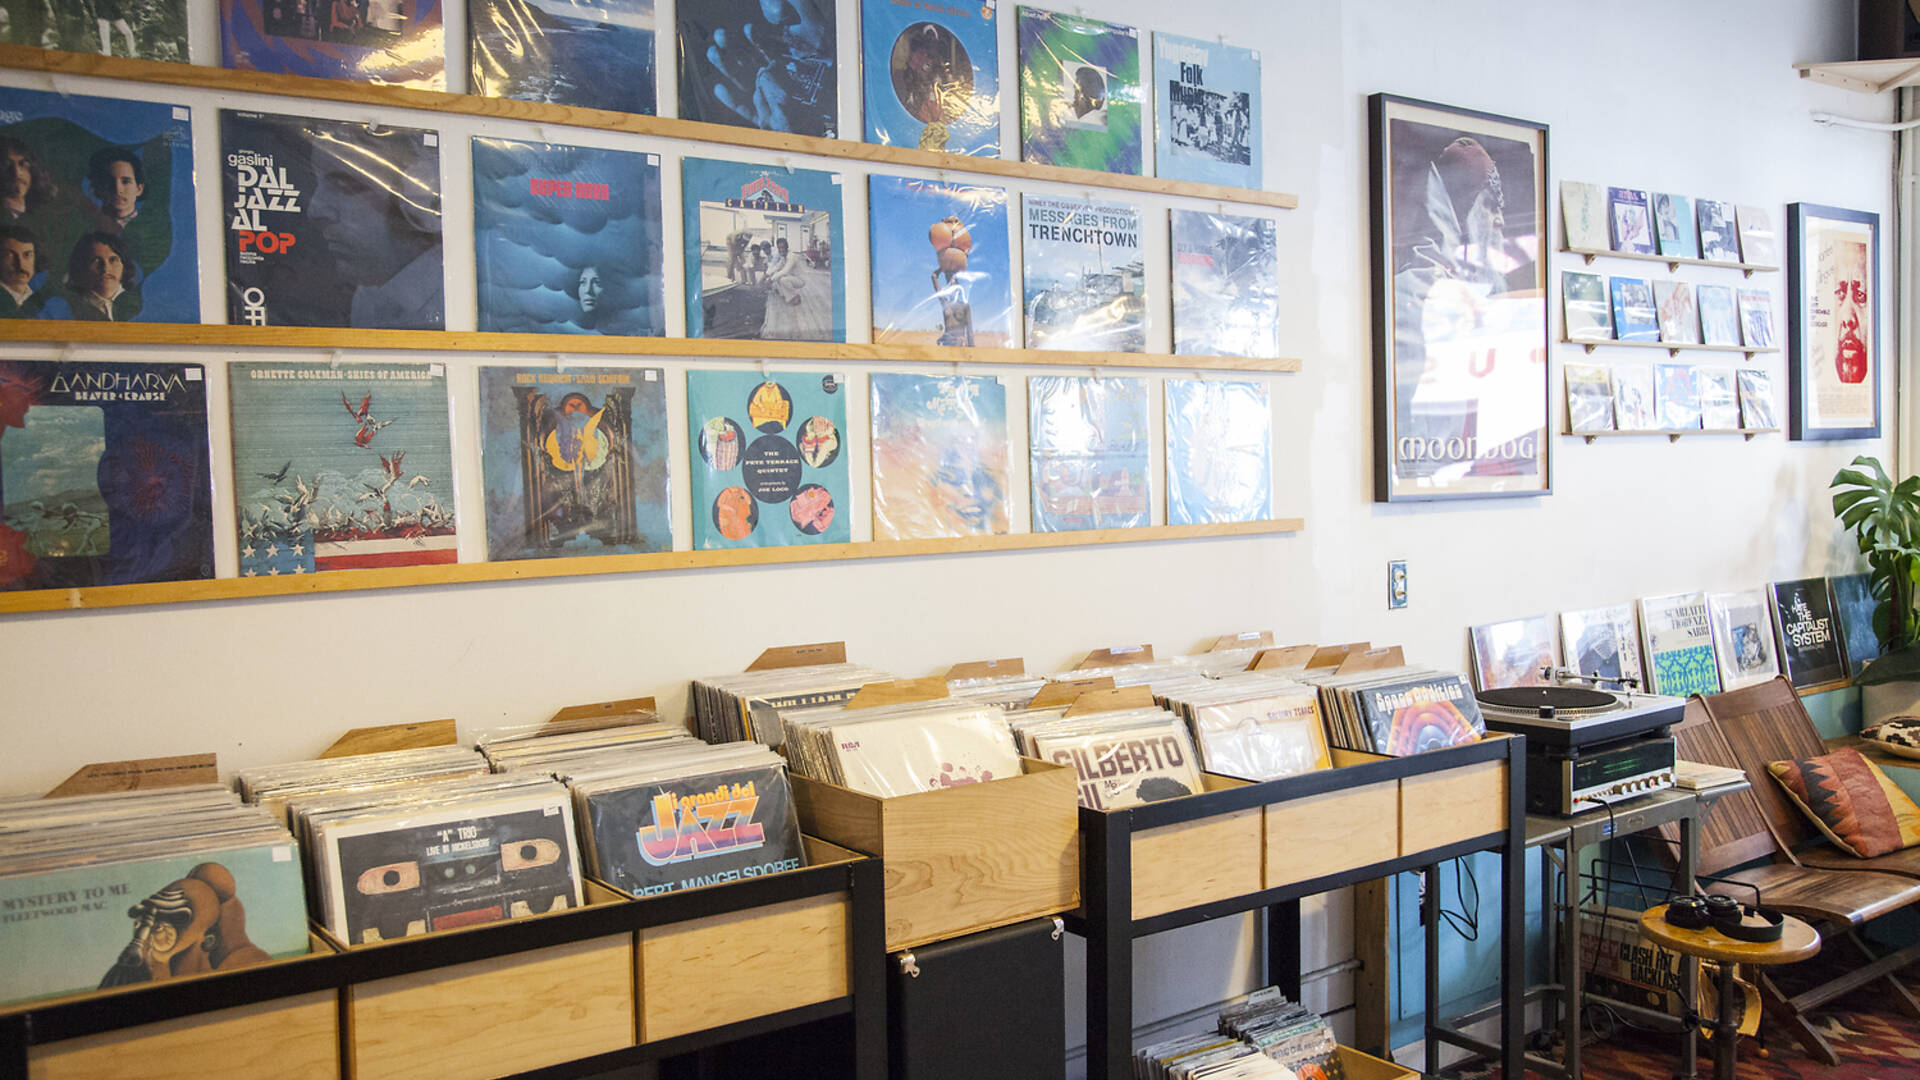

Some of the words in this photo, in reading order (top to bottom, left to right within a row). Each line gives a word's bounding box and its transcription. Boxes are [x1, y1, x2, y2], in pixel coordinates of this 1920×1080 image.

[1181, 62, 1203, 87] Folk
[227, 153, 273, 167] gaslini
[238, 165, 294, 190] DAL
[530, 178, 572, 198] SUPER
[575, 182, 609, 200] NOVA
[234, 187, 301, 212] JAZZ
[231, 208, 267, 231] AL
[1029, 208, 1098, 227] MESSAGES
[1102, 216, 1137, 230] FROM
[239, 230, 296, 254] POP
[1029, 224, 1137, 248] TRENCHTOWN
[250, 370, 296, 379] ORNETTE
[298, 370, 343, 379] COLEMAN
[75, 391, 116, 401] BEAVER
[124, 391, 166, 401] KRAUSE
[1787, 618, 1828, 635] CAPITALIST
[1798, 610, 1812, 621] THE
[1793, 629, 1831, 647] SYSTEM
[1053, 736, 1184, 781] GILBERTO
[680, 784, 730, 808] grandi
[731, 780, 756, 799] del
[1078, 783, 1111, 811] IL
[457, 826, 477, 840] TRIO
[636, 793, 766, 865] JAZZ
[426, 845, 440, 856] LIVE
[4, 891, 77, 910] MYSTERY
[83, 886, 104, 900] TO
[109, 883, 131, 896] ME
[3, 905, 78, 924] FLEETWOOD
[81, 900, 108, 912] MAC
[1631, 963, 1680, 993] BACKLAS
